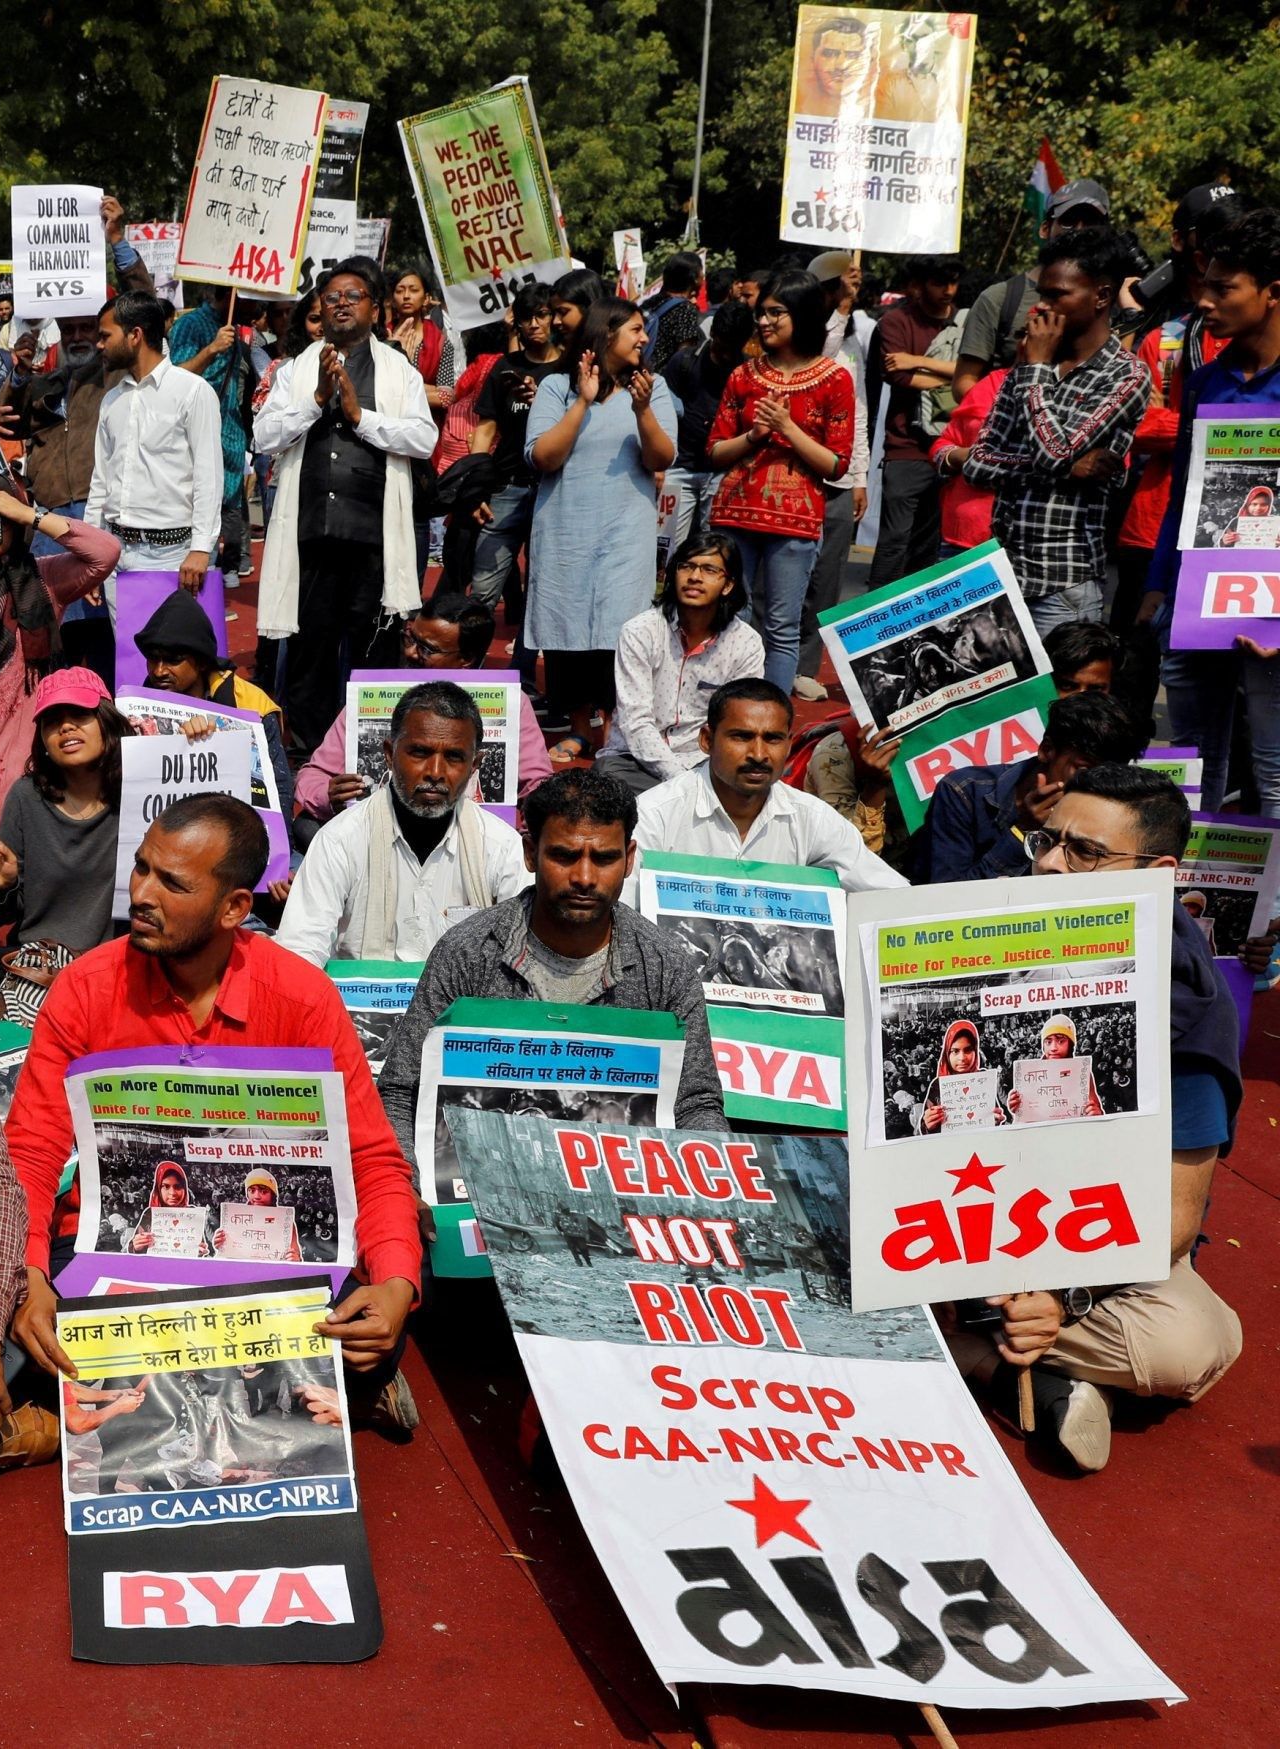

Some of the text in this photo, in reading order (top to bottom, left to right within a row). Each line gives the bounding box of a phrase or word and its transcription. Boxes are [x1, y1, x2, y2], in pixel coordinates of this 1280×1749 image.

[434, 124, 504, 165] WE, THE
[229, 165, 258, 192] बिना
[328, 166, 344, 176] and
[442, 150, 513, 194] PEOPLE
[38, 197, 79, 218] DU FOR
[451, 179, 521, 217] OF INDIA
[129, 223, 180, 240] KYS
[310, 209, 337, 221] eace,
[455, 202, 524, 242] REJECT
[27, 223, 91, 245] COMMUNAL
[29, 250, 90, 271] HARMONY!
[228, 242, 285, 286] AISA
[462, 229, 533, 273] NRC
[36, 280, 84, 298] KYS
[1213, 428, 1264, 438] No More
[1208, 446, 1253, 455] Unite for
[359, 706, 380, 714] Unite
[362, 690, 401, 699] No More
[891, 685, 966, 726] CAA-NRC-NPR
[161, 752, 219, 785] DU FOR
[913, 718, 1040, 795] RYA
[1205, 831, 1267, 846] Violence!
[1207, 849, 1263, 862] Harmony!
[1174, 872, 1256, 887] CAA-NRC-NPR!
[886, 909, 1130, 949] No More Communal Violence!
[881, 938, 1130, 977] Unite for Peace. Justice. Harmony!
[984, 978, 1129, 1010] Scrap CAA-NRC-NPR!
[443, 1036, 616, 1060] साम्प्रदायिक हिंसा के खिलाफ
[94, 1079, 318, 1098] No More Communal Violence!
[485, 1062, 659, 1085] संविधान पर हमले के खिलाफ!
[711, 1040, 831, 1105] RYA
[93, 1104, 321, 1123] Unite for Peace. Justice. Harmony!
[187, 1142, 323, 1159] Scrap CAA-NRC-NPR!
[554, 1128, 775, 1204] PEACE
[622, 1215, 746, 1270] NOT
[881, 1183, 1141, 1272] aisa
[63, 1307, 262, 1342] आज जो दिल्ली में हुआ
[624, 1281, 809, 1353] RIOT
[651, 1364, 856, 1437] Scrap
[581, 1422, 980, 1480] CAA-NRC-NPR
[82, 1484, 340, 1527] Scrap CAA-NRC-NPR!
[119, 1572, 336, 1625] RYA
[664, 1547, 1093, 1685] aisa
